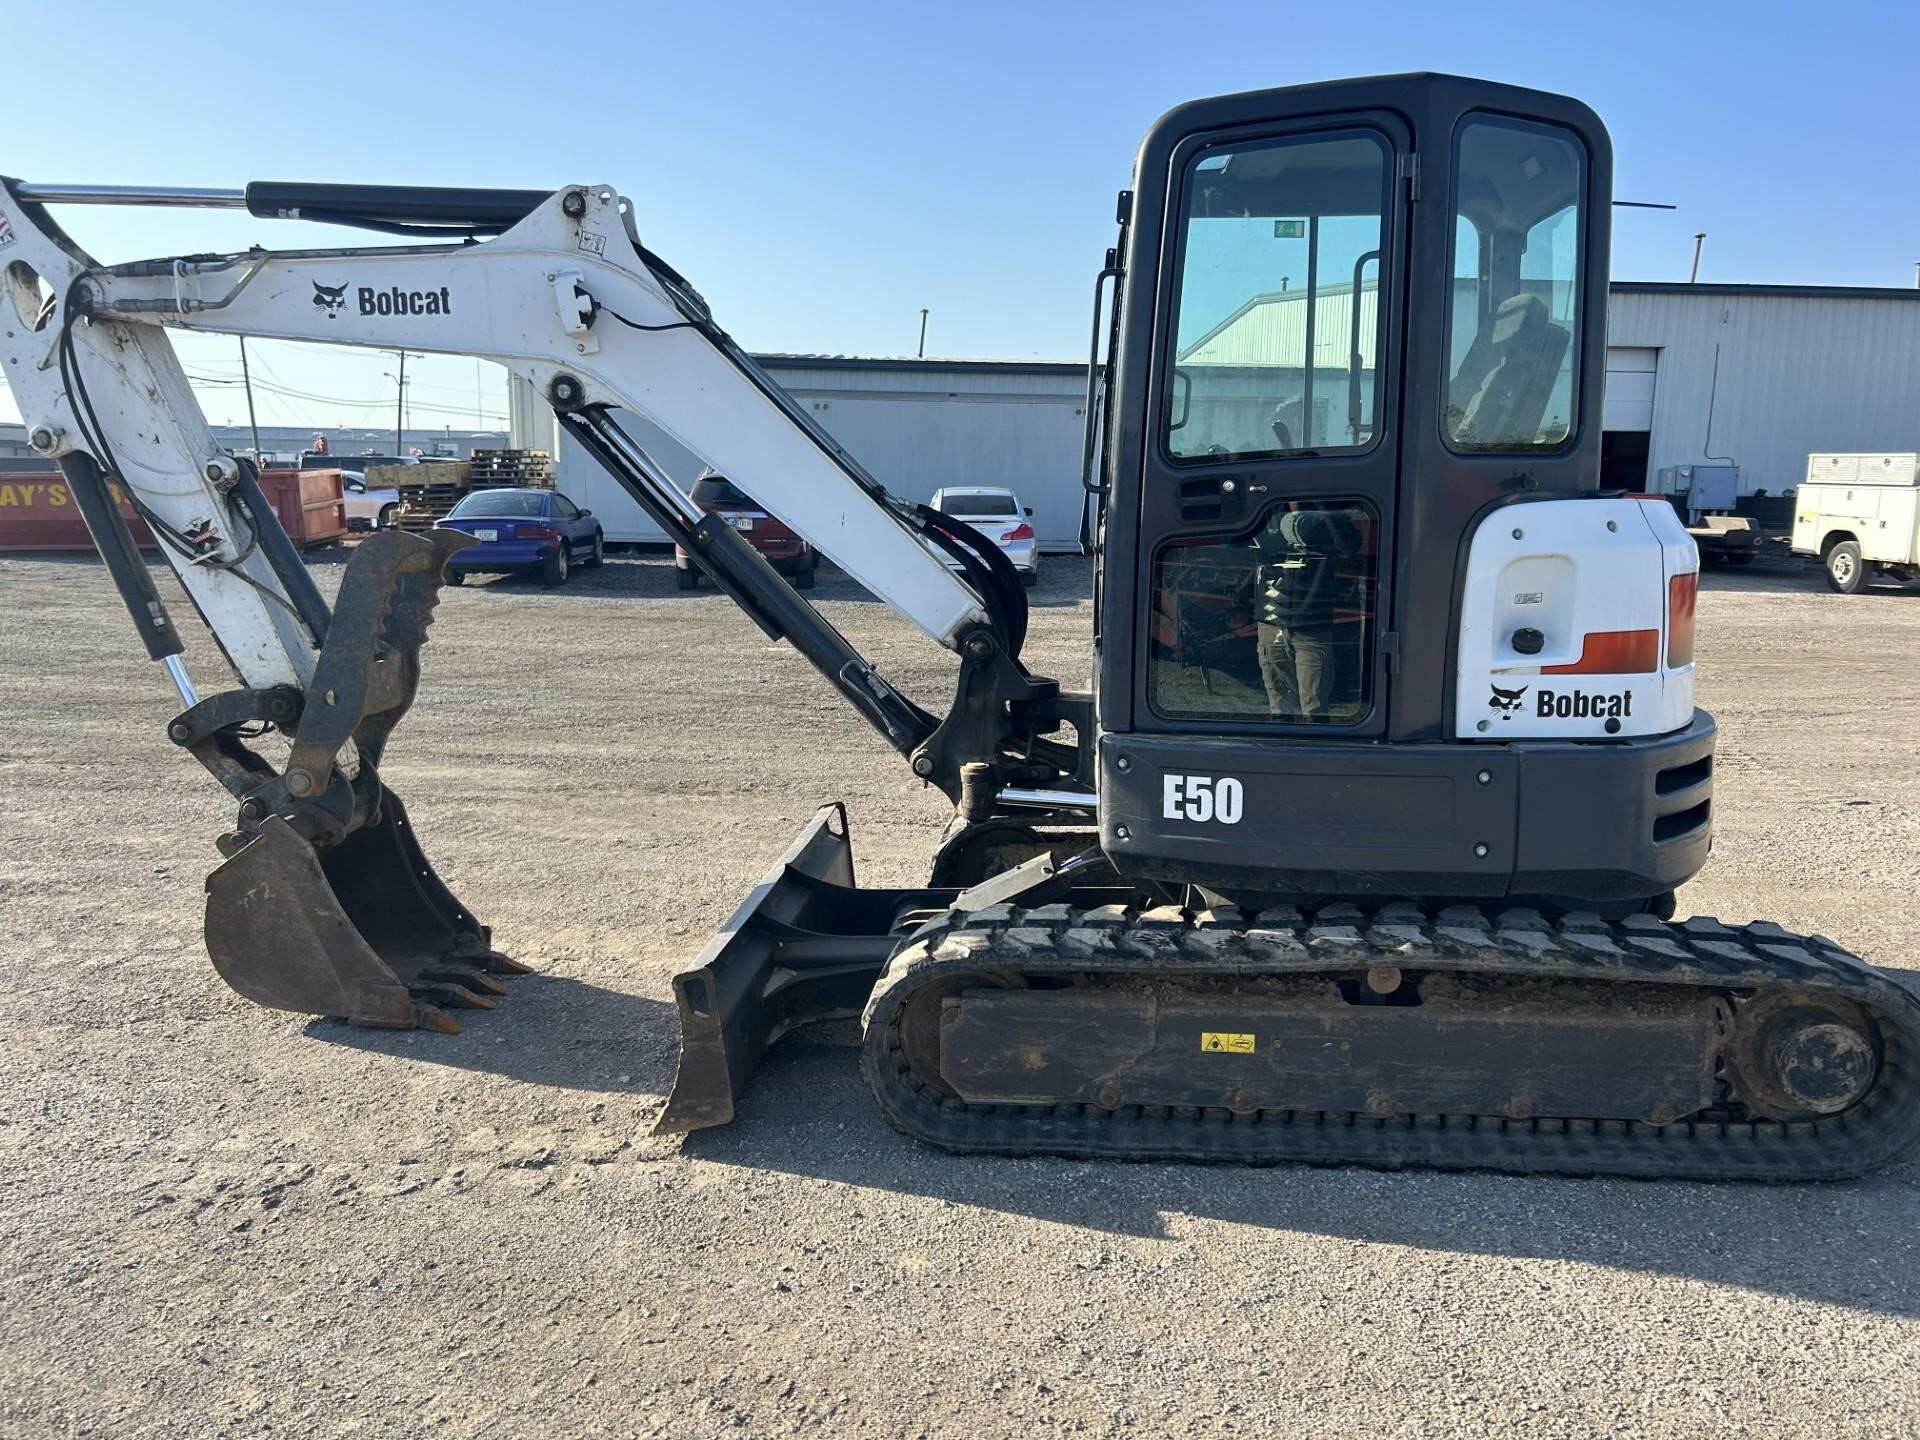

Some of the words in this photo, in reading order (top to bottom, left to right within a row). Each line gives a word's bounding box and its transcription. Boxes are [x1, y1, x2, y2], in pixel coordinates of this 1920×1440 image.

[358, 287, 451, 316] Bobcat
[1537, 690, 1632, 718] Bobcat
[1163, 774, 1243, 825] E50
